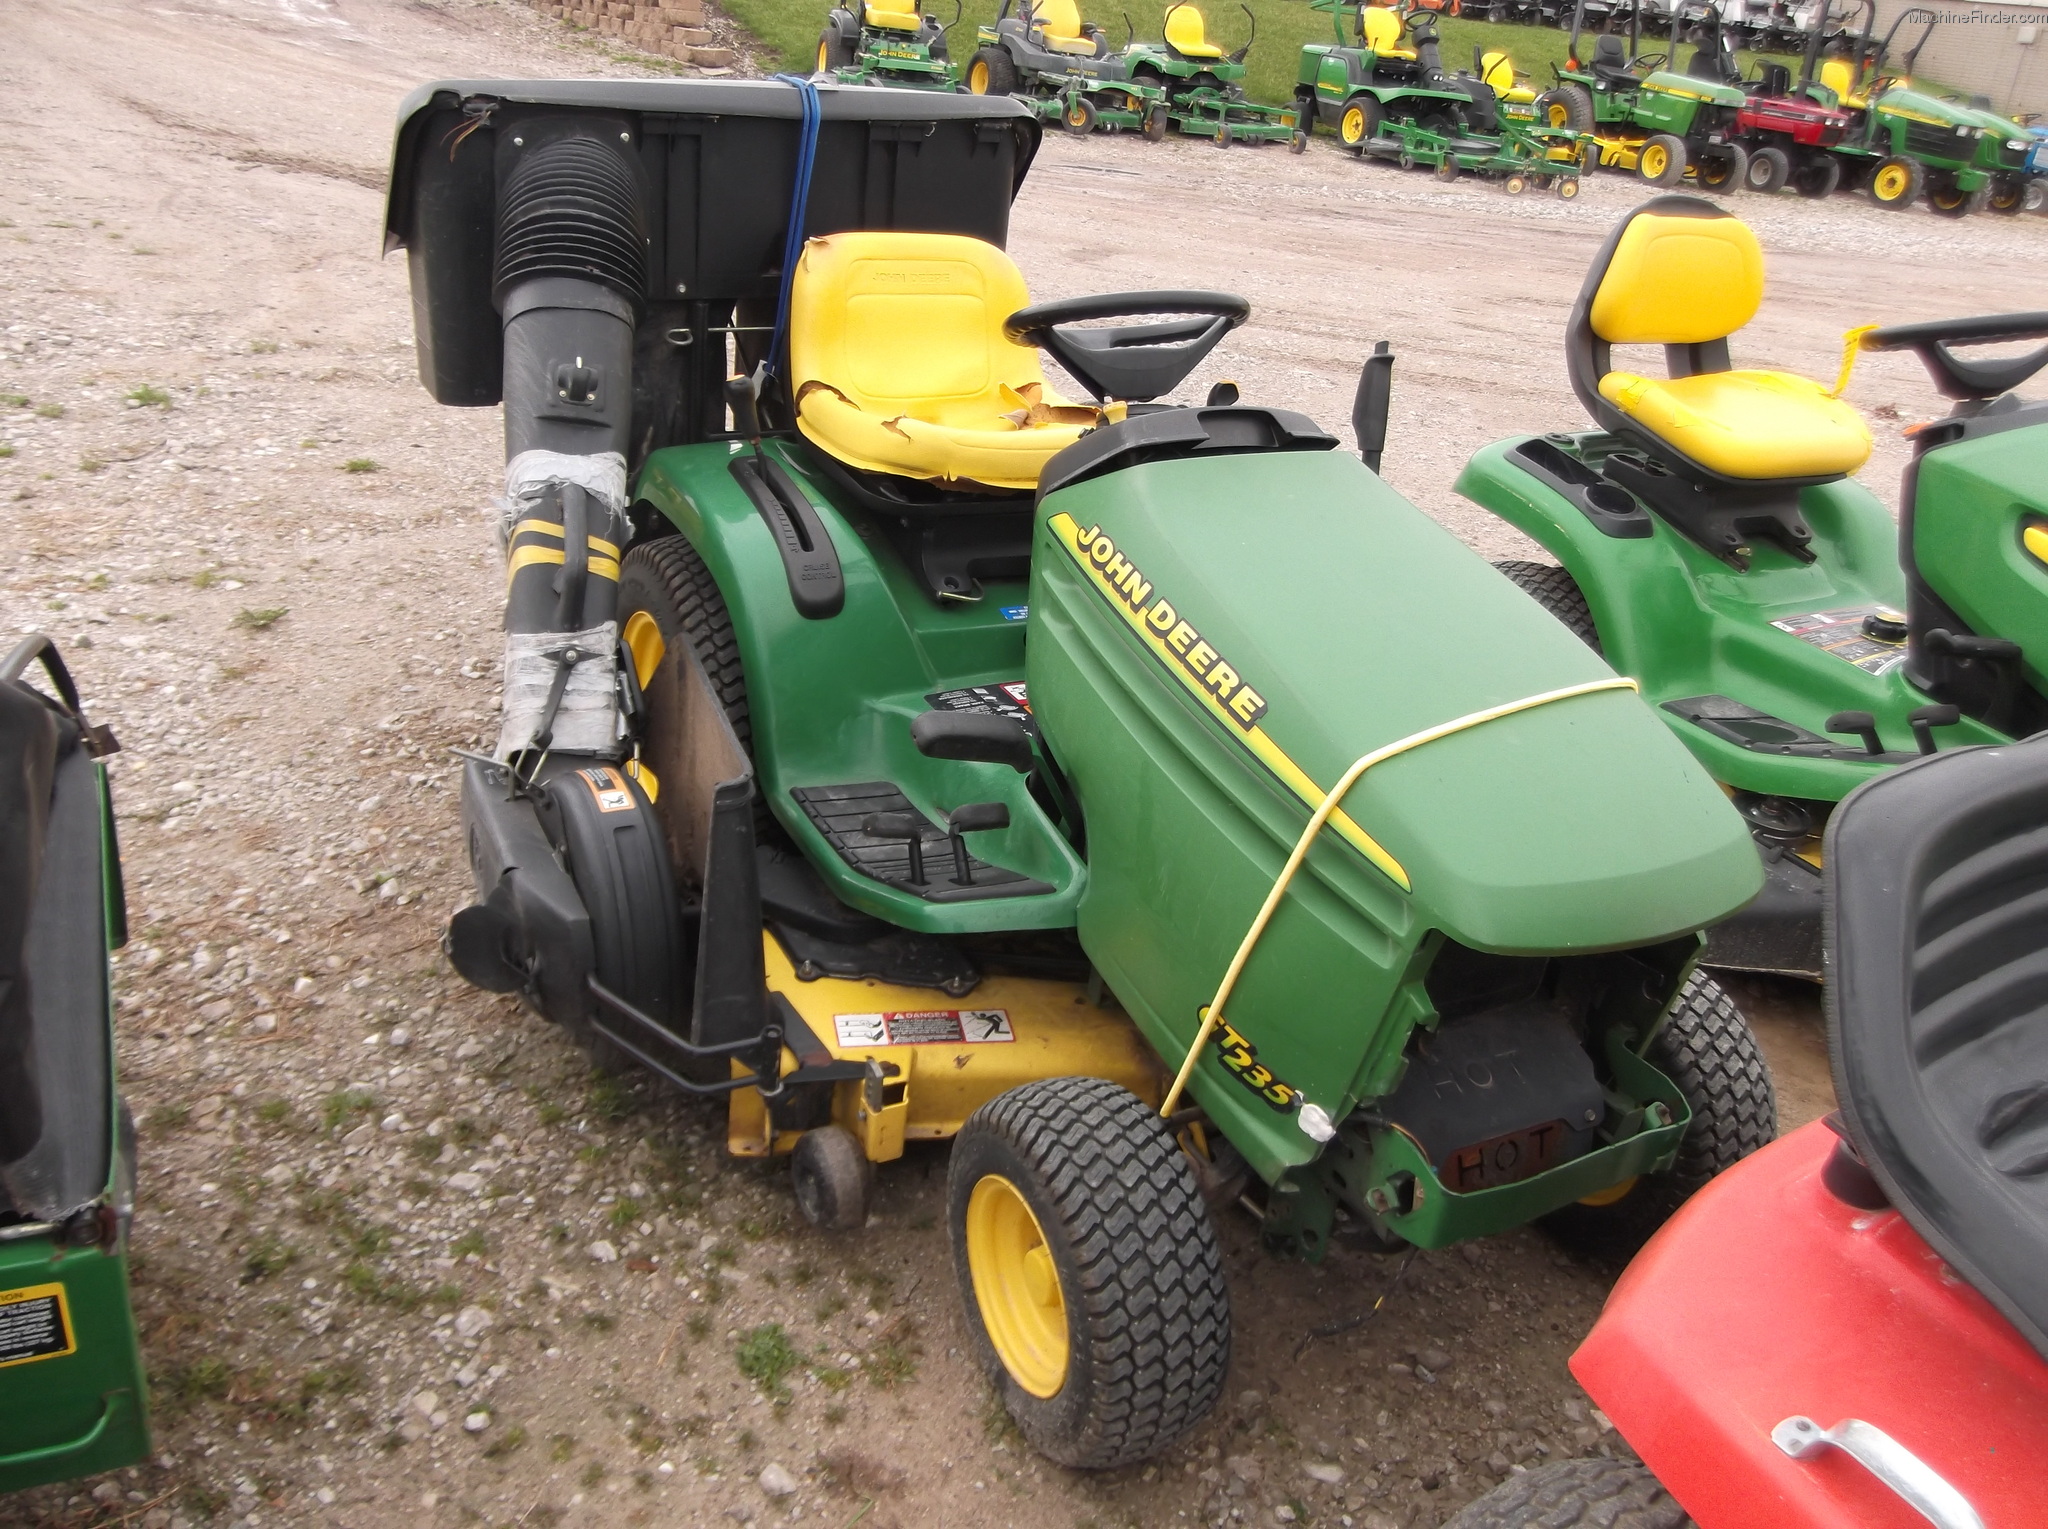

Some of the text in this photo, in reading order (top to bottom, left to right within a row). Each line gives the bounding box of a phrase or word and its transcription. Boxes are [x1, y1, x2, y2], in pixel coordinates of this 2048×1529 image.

[1077, 524, 1267, 731] JOHN DEERE
[1434, 1049, 1527, 1100] HOT
[1457, 1126, 1554, 1187] HOT
